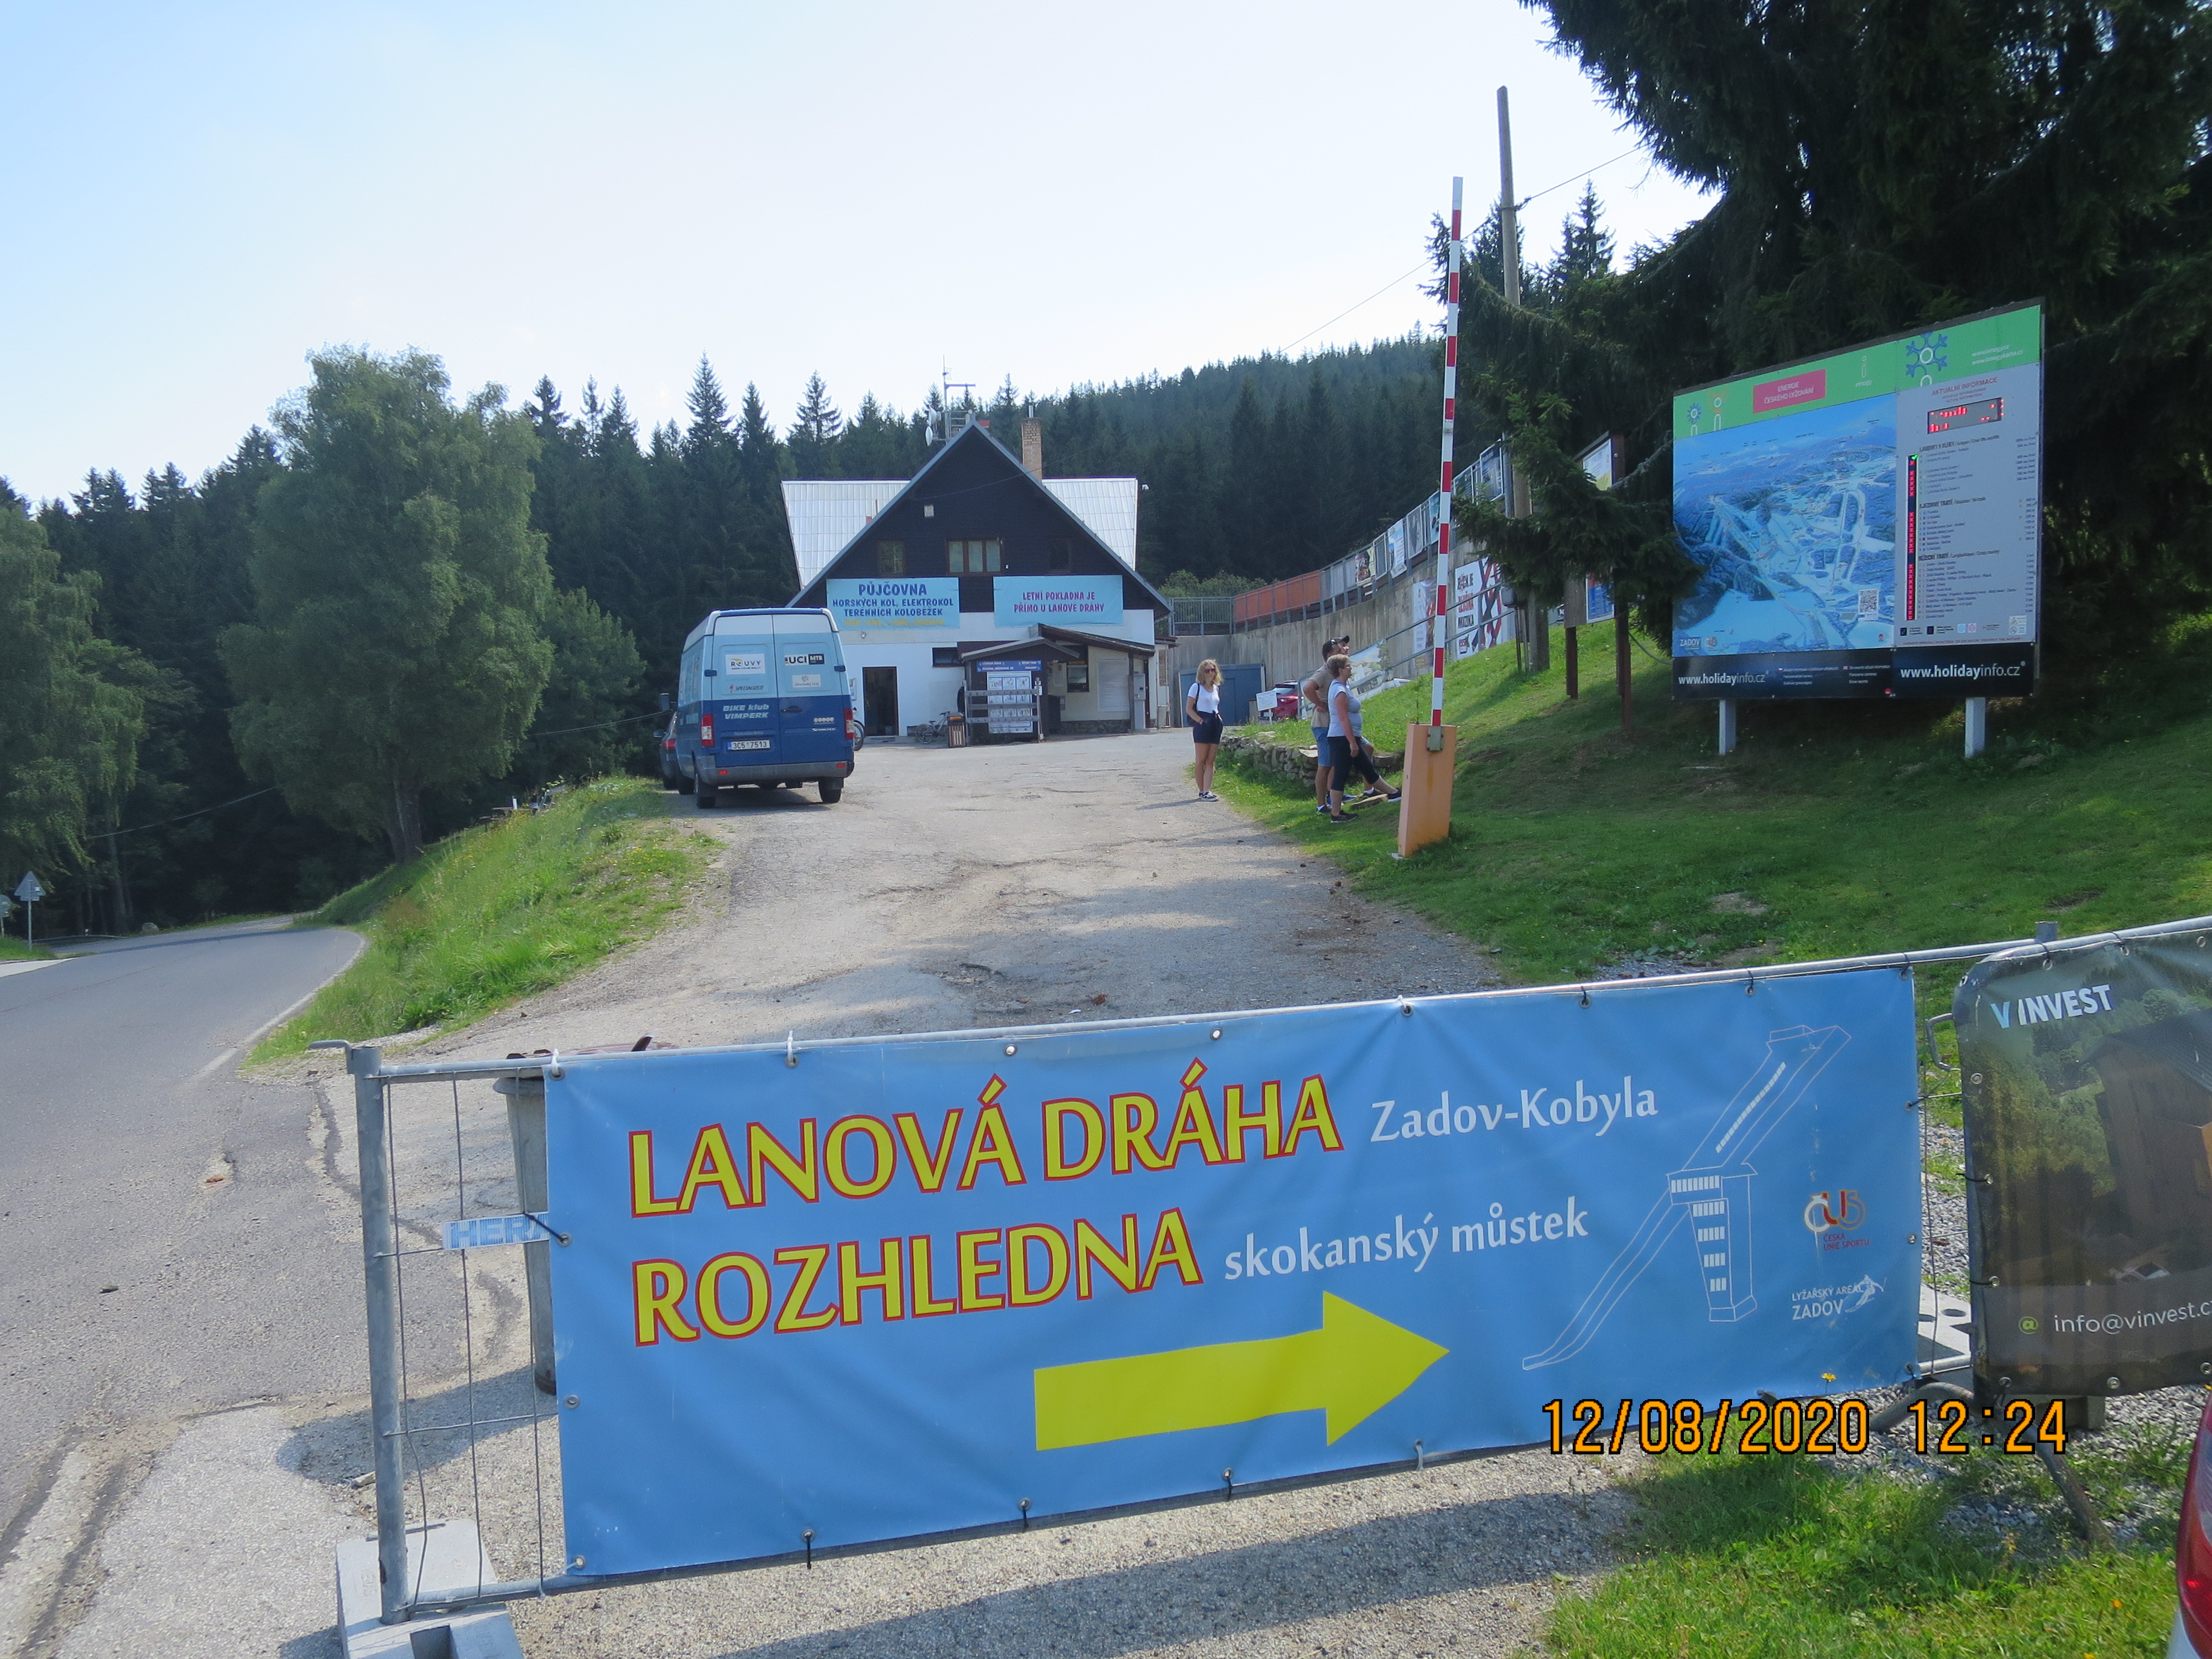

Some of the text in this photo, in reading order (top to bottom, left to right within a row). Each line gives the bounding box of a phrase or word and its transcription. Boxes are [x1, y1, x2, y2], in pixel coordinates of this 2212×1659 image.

[1777, 382, 1800, 392] ENERGIE
[1961, 377, 1998, 390] INFORMACE
[858, 581, 927, 596] PŮJČOVNA
[1022, 589, 1095, 601] LETNÍ POKLADNA JE
[833, 597, 954, 607] HORSKÝCH KOL, ELEKTROKOL
[1014, 602, 1104, 613] PŘÍMO U LANOVÉ DRÁHY
[894, 607, 943, 616] KOLOBĚŽEK
[789, 656, 807, 664] UCI
[1900, 663, 2021, 680] www.holidayinfo.cz
[1678, 672, 1765, 686] www.holidayinfo.cz
[1991, 984, 2113, 1029] V INVEST
[628, 1057, 1658, 1218] LANOVÁ DRÁHA Zadov-Kobyla
[1823, 1233, 1846, 1242] ČESKÁ
[1842, 1239, 1870, 1249] SPORTU
[632, 1196, 1588, 1347] ROZHLEDNA skokanský můstek
[1792, 1282, 1865, 1302] LYŽAŘSKÝ AREÁL
[1792, 1299, 1844, 1321] ZADOV
